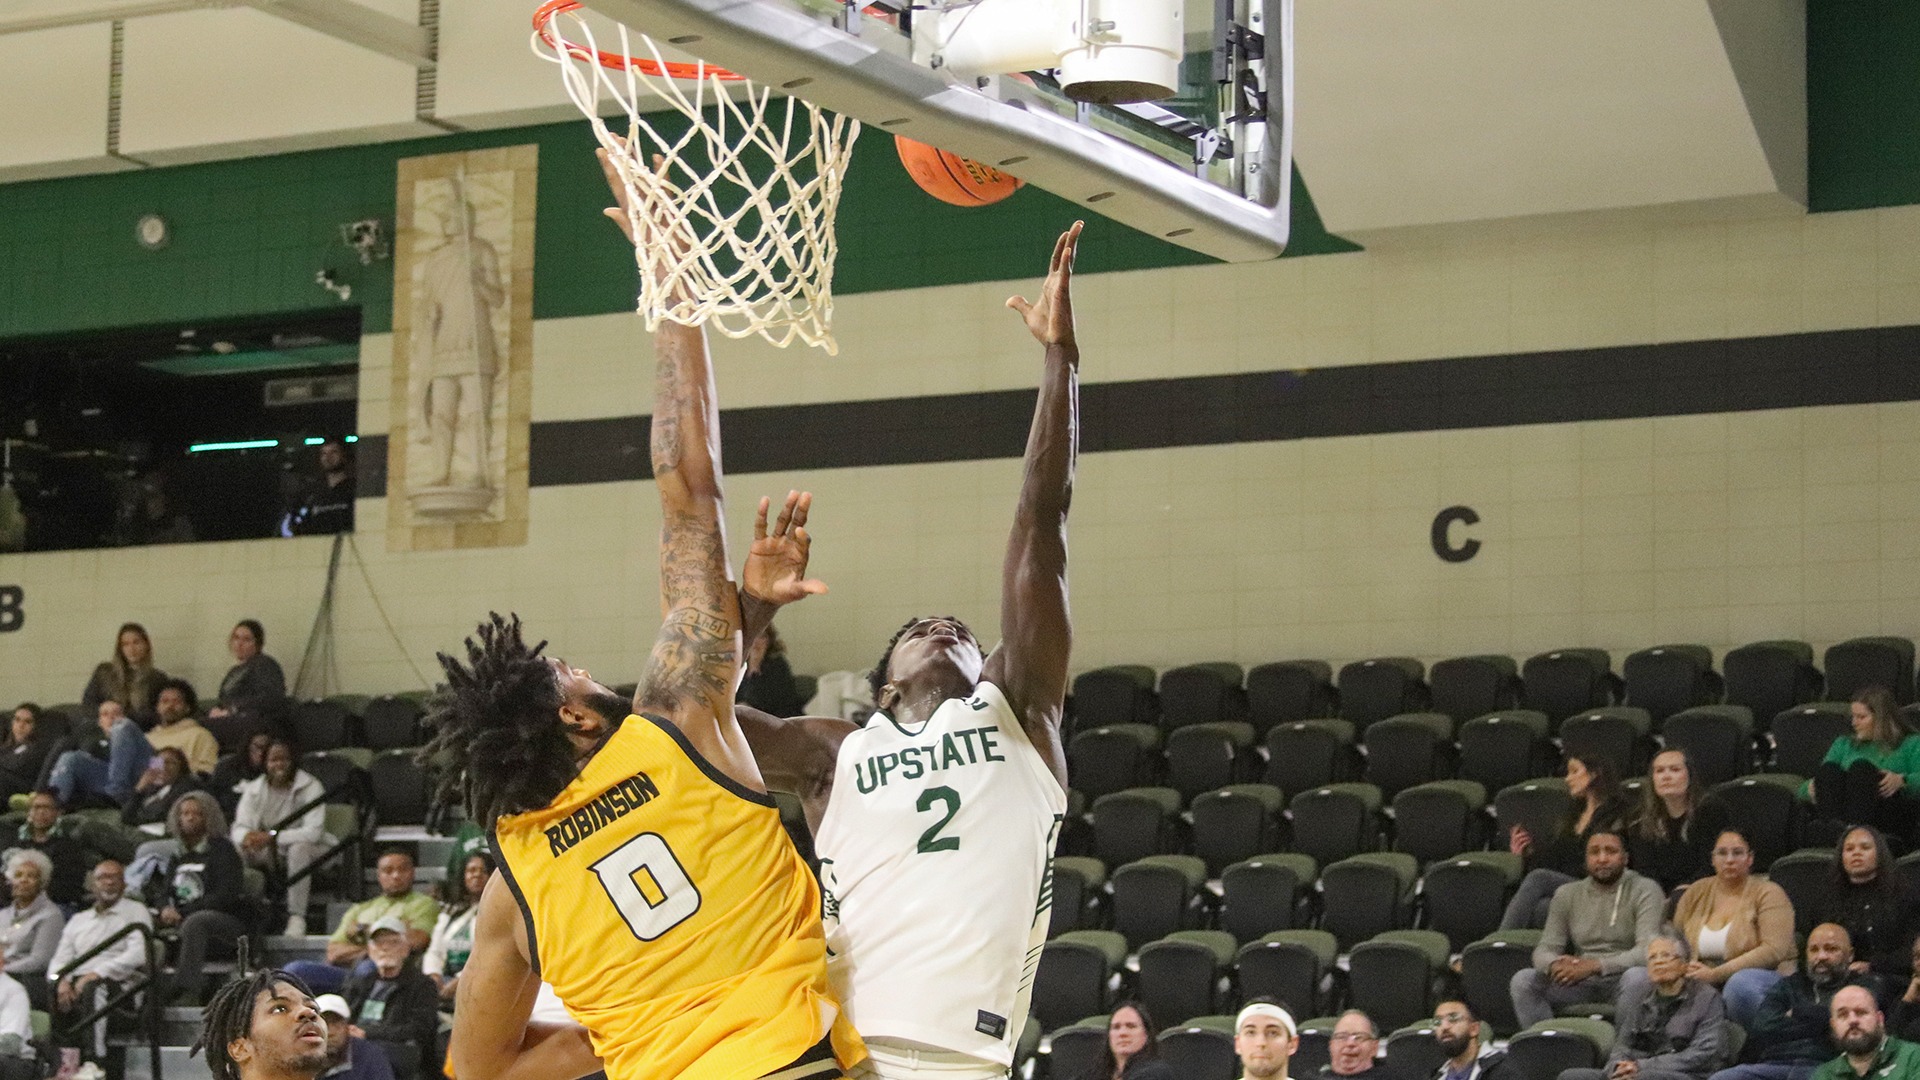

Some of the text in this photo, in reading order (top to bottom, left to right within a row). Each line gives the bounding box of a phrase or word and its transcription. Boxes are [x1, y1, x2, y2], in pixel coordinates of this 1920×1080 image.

[1430, 505, 1482, 563] C
[0, 585, 25, 633] B
[855, 725, 1006, 794] UPSTATE
[543, 771, 661, 858] ROBINSON
[916, 785, 962, 854] 2
[586, 831, 702, 942] 0
